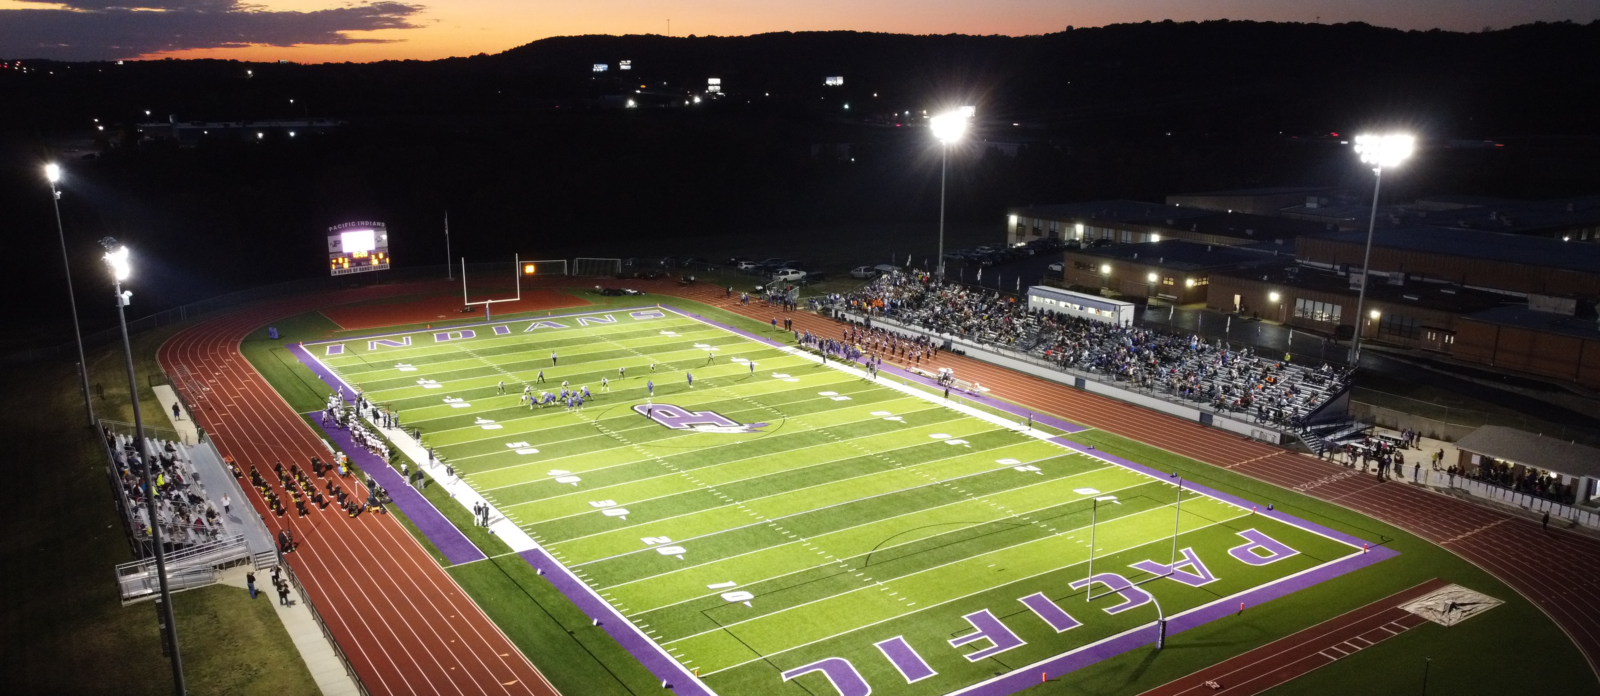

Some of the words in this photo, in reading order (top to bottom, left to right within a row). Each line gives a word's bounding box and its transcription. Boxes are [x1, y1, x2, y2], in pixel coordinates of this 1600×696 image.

[328, 221, 356, 231] PACIFIC
[325, 309, 666, 356] INDIANS
[588, 499, 630, 517] 30
[640, 535, 687, 556] 20
[706, 580, 755, 603] 10
